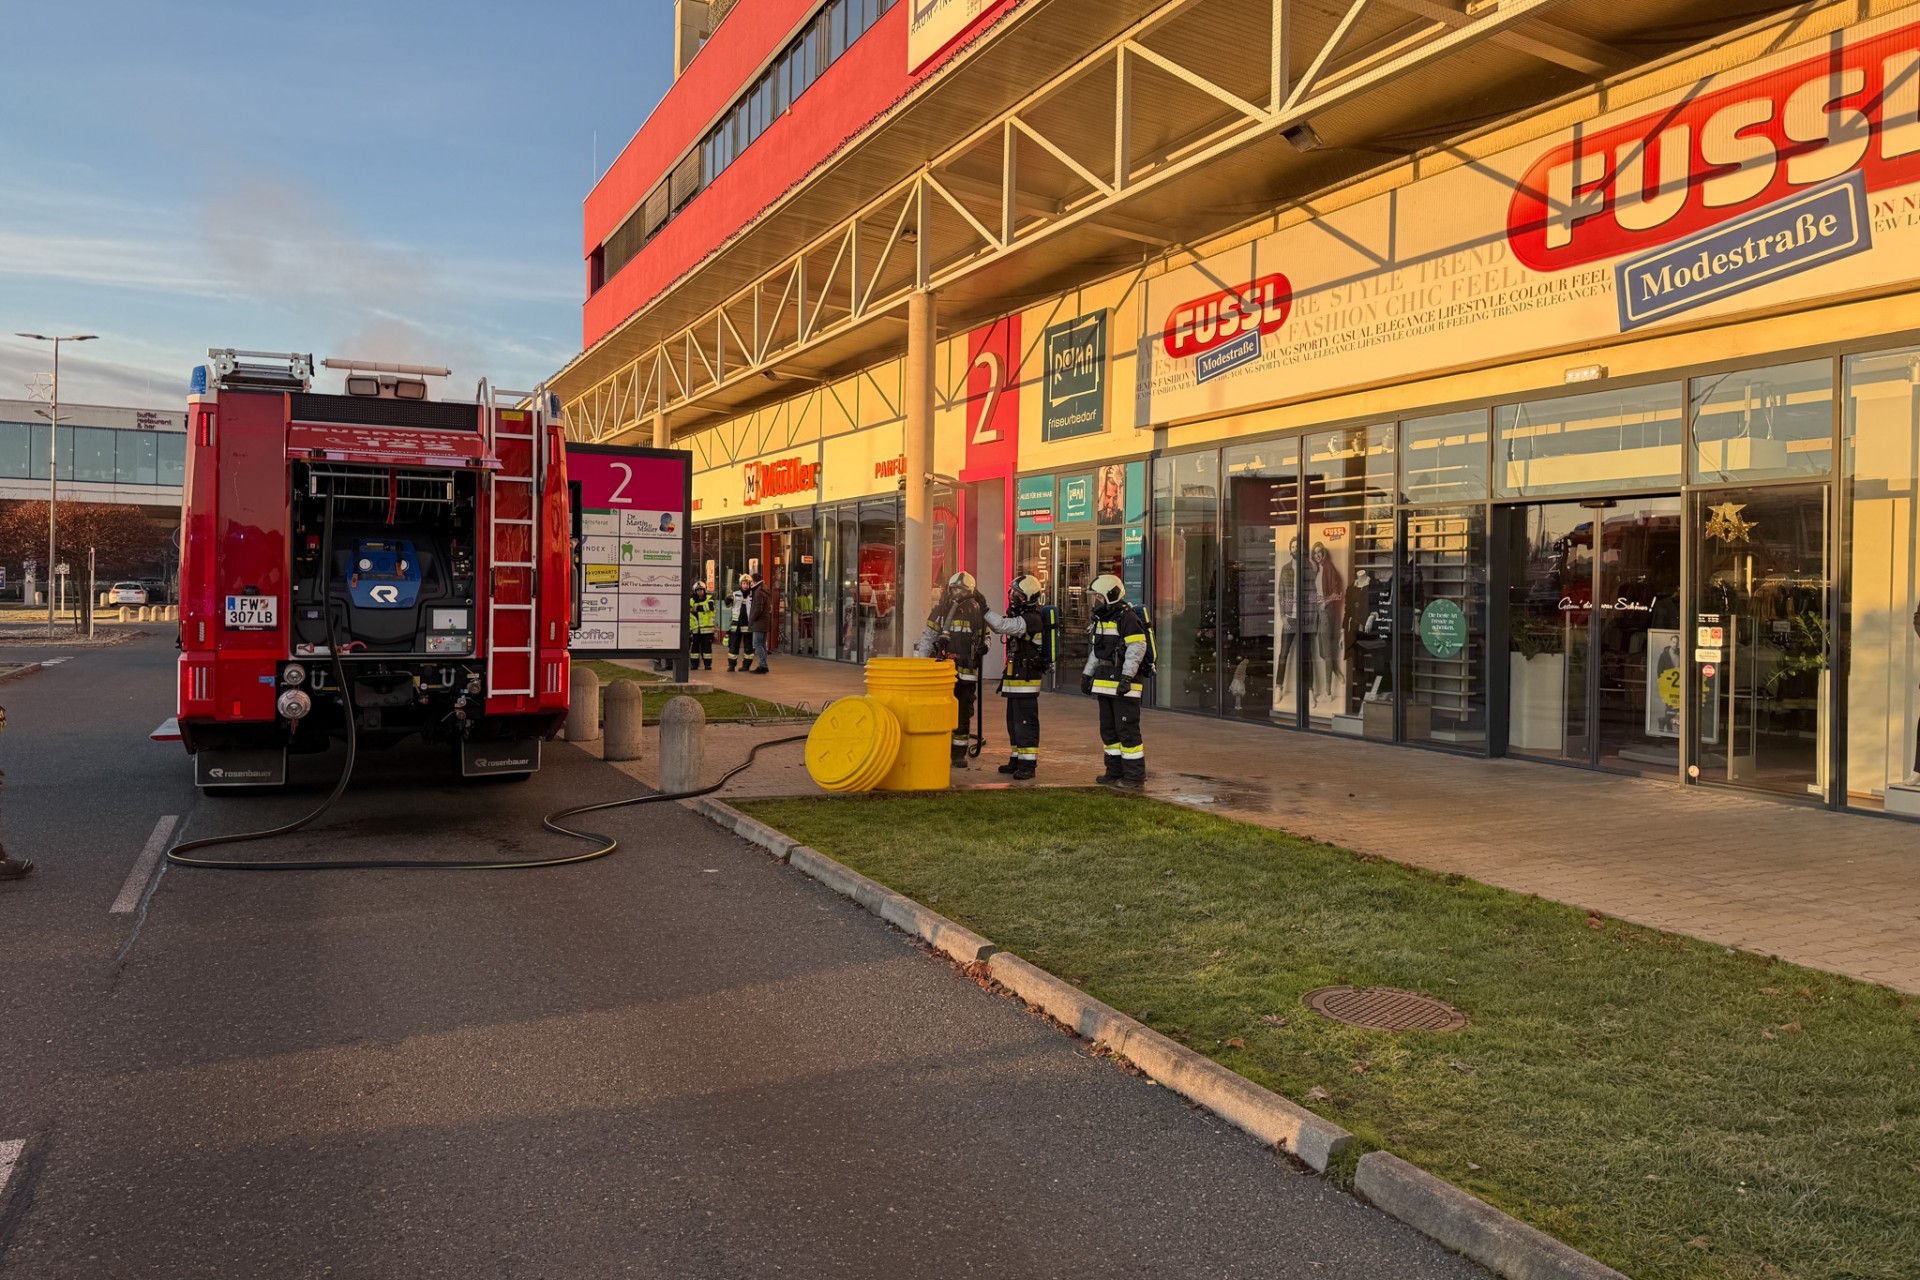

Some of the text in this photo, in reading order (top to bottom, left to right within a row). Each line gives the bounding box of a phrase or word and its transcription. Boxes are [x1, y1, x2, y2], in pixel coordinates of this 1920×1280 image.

[1545, 48, 1920, 250] FUSSL
[1640, 211, 1838, 302] Modestraße
[1175, 282, 1282, 349] FUSSL
[1288, 301, 1378, 343] FASHION
[1385, 283, 1442, 317] CHIC
[1293, 335, 1331, 353] SPORTY
[1332, 326, 1373, 345] CASUAL
[1375, 310, 1436, 335] ELEGANCE
[1438, 292, 1507, 319] LIFESTYLE
[1509, 278, 1568, 303] COLOUR
[1571, 268, 1611, 288] FEEL
[1313, 341, 1355, 359] ELEGANCE
[1357, 330, 1404, 348] LIFESTYLE
[1405, 319, 1444, 341] COLOUR
[1446, 309, 1489, 328] FEELING
[1491, 300, 1534, 318] TRENDS
[1535, 285, 1598, 308] ELEGANCE
[1053, 343, 1094, 386] ROMA
[1202, 341, 1255, 374] Modestraße
[971, 351, 1004, 445] 2
[293, 426, 480, 441] FEUERWEHR
[608, 462, 633, 503] 2
[760, 457, 822, 498] Müller
[1325, 528, 1345, 536] FUSSL
[230, 611, 272, 623] 307 LB
[240, 598, 259, 611] FW
[224, 769, 272, 778] rosenbauer
